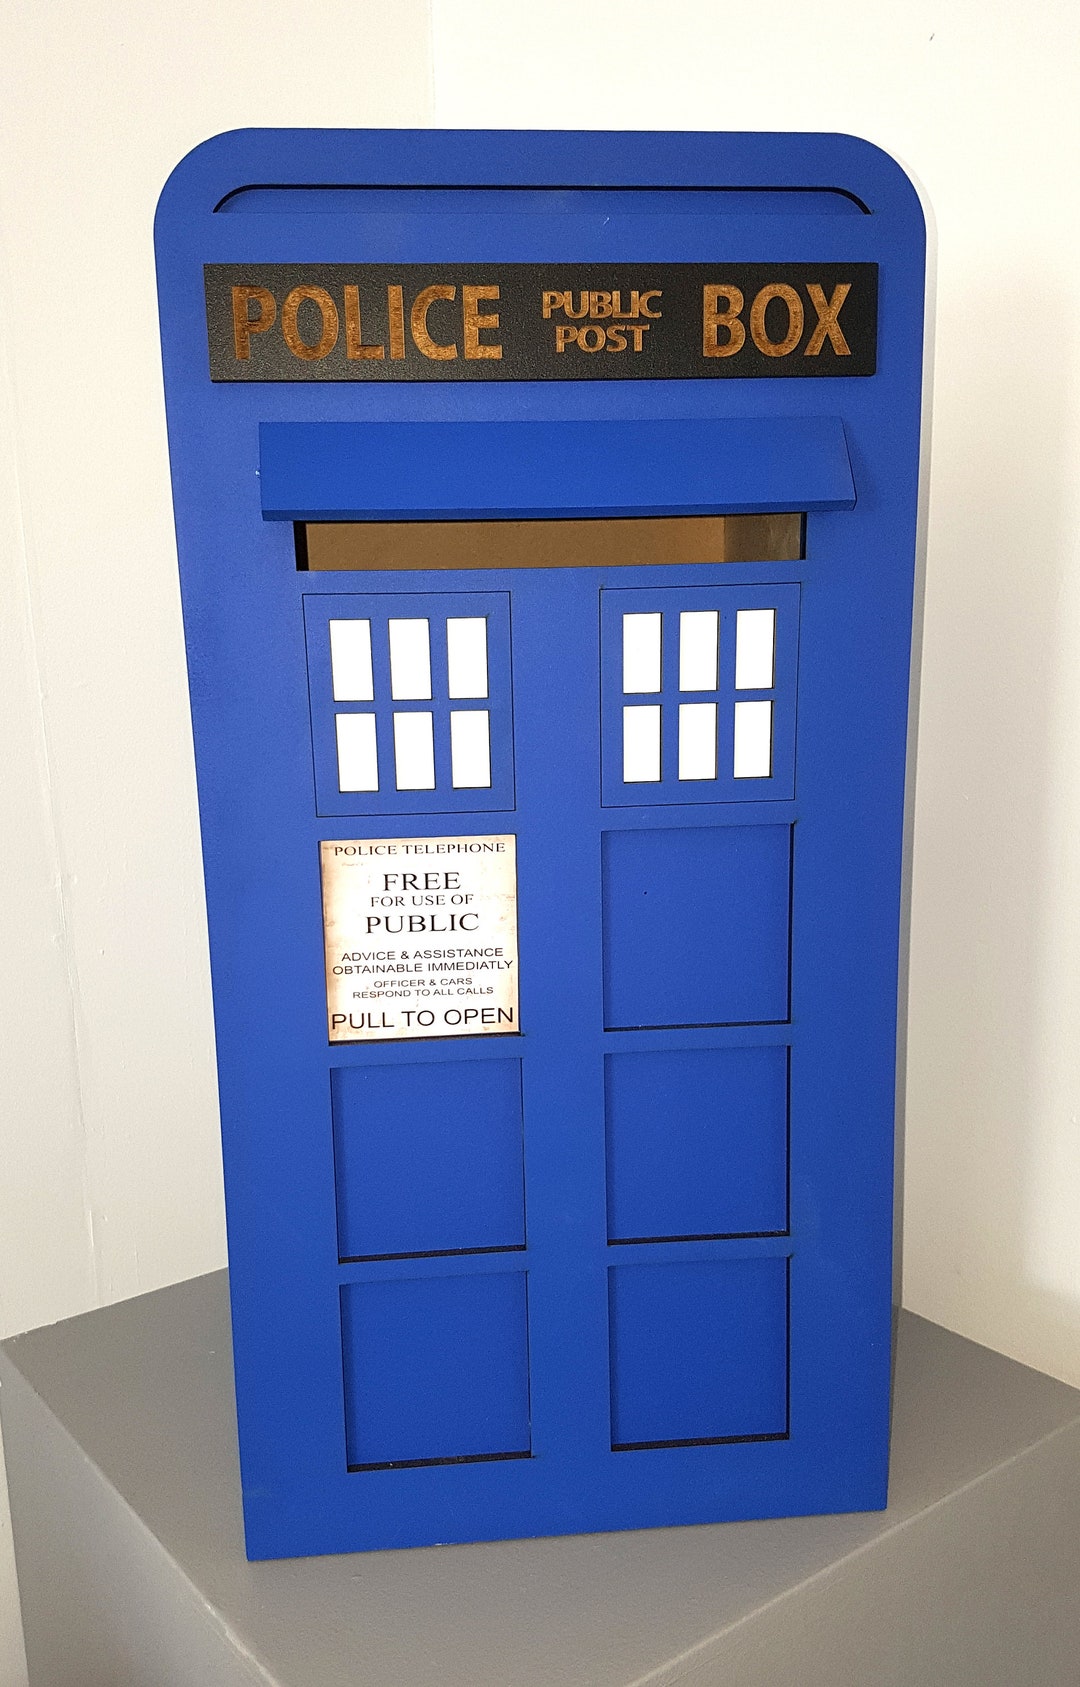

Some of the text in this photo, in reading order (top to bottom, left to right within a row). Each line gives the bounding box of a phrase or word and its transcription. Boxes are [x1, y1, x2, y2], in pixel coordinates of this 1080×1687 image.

[542, 290, 662, 319] PUBLIC
[231, 284, 502, 360] POLICE
[702, 283, 852, 357] BOX
[555, 325, 650, 353] POST
[334, 843, 506, 856] POLICE TELEPHONE
[383, 872, 461, 891] FREE
[371, 894, 474, 907] FOR USE OF
[366, 913, 479, 933] PUBLIC
[341, 948, 504, 961] ADVICE & ASSISTANCE
[332, 960, 513, 975] OBTAINABLE IMMEDIATLY
[353, 990, 411, 998] RESPOND
[433, 988, 453, 996] ALL
[457, 987, 494, 995] CALLS
[374, 980, 425, 988] OFFICER
[332, 1007, 513, 1029] PULL TO OPEN
